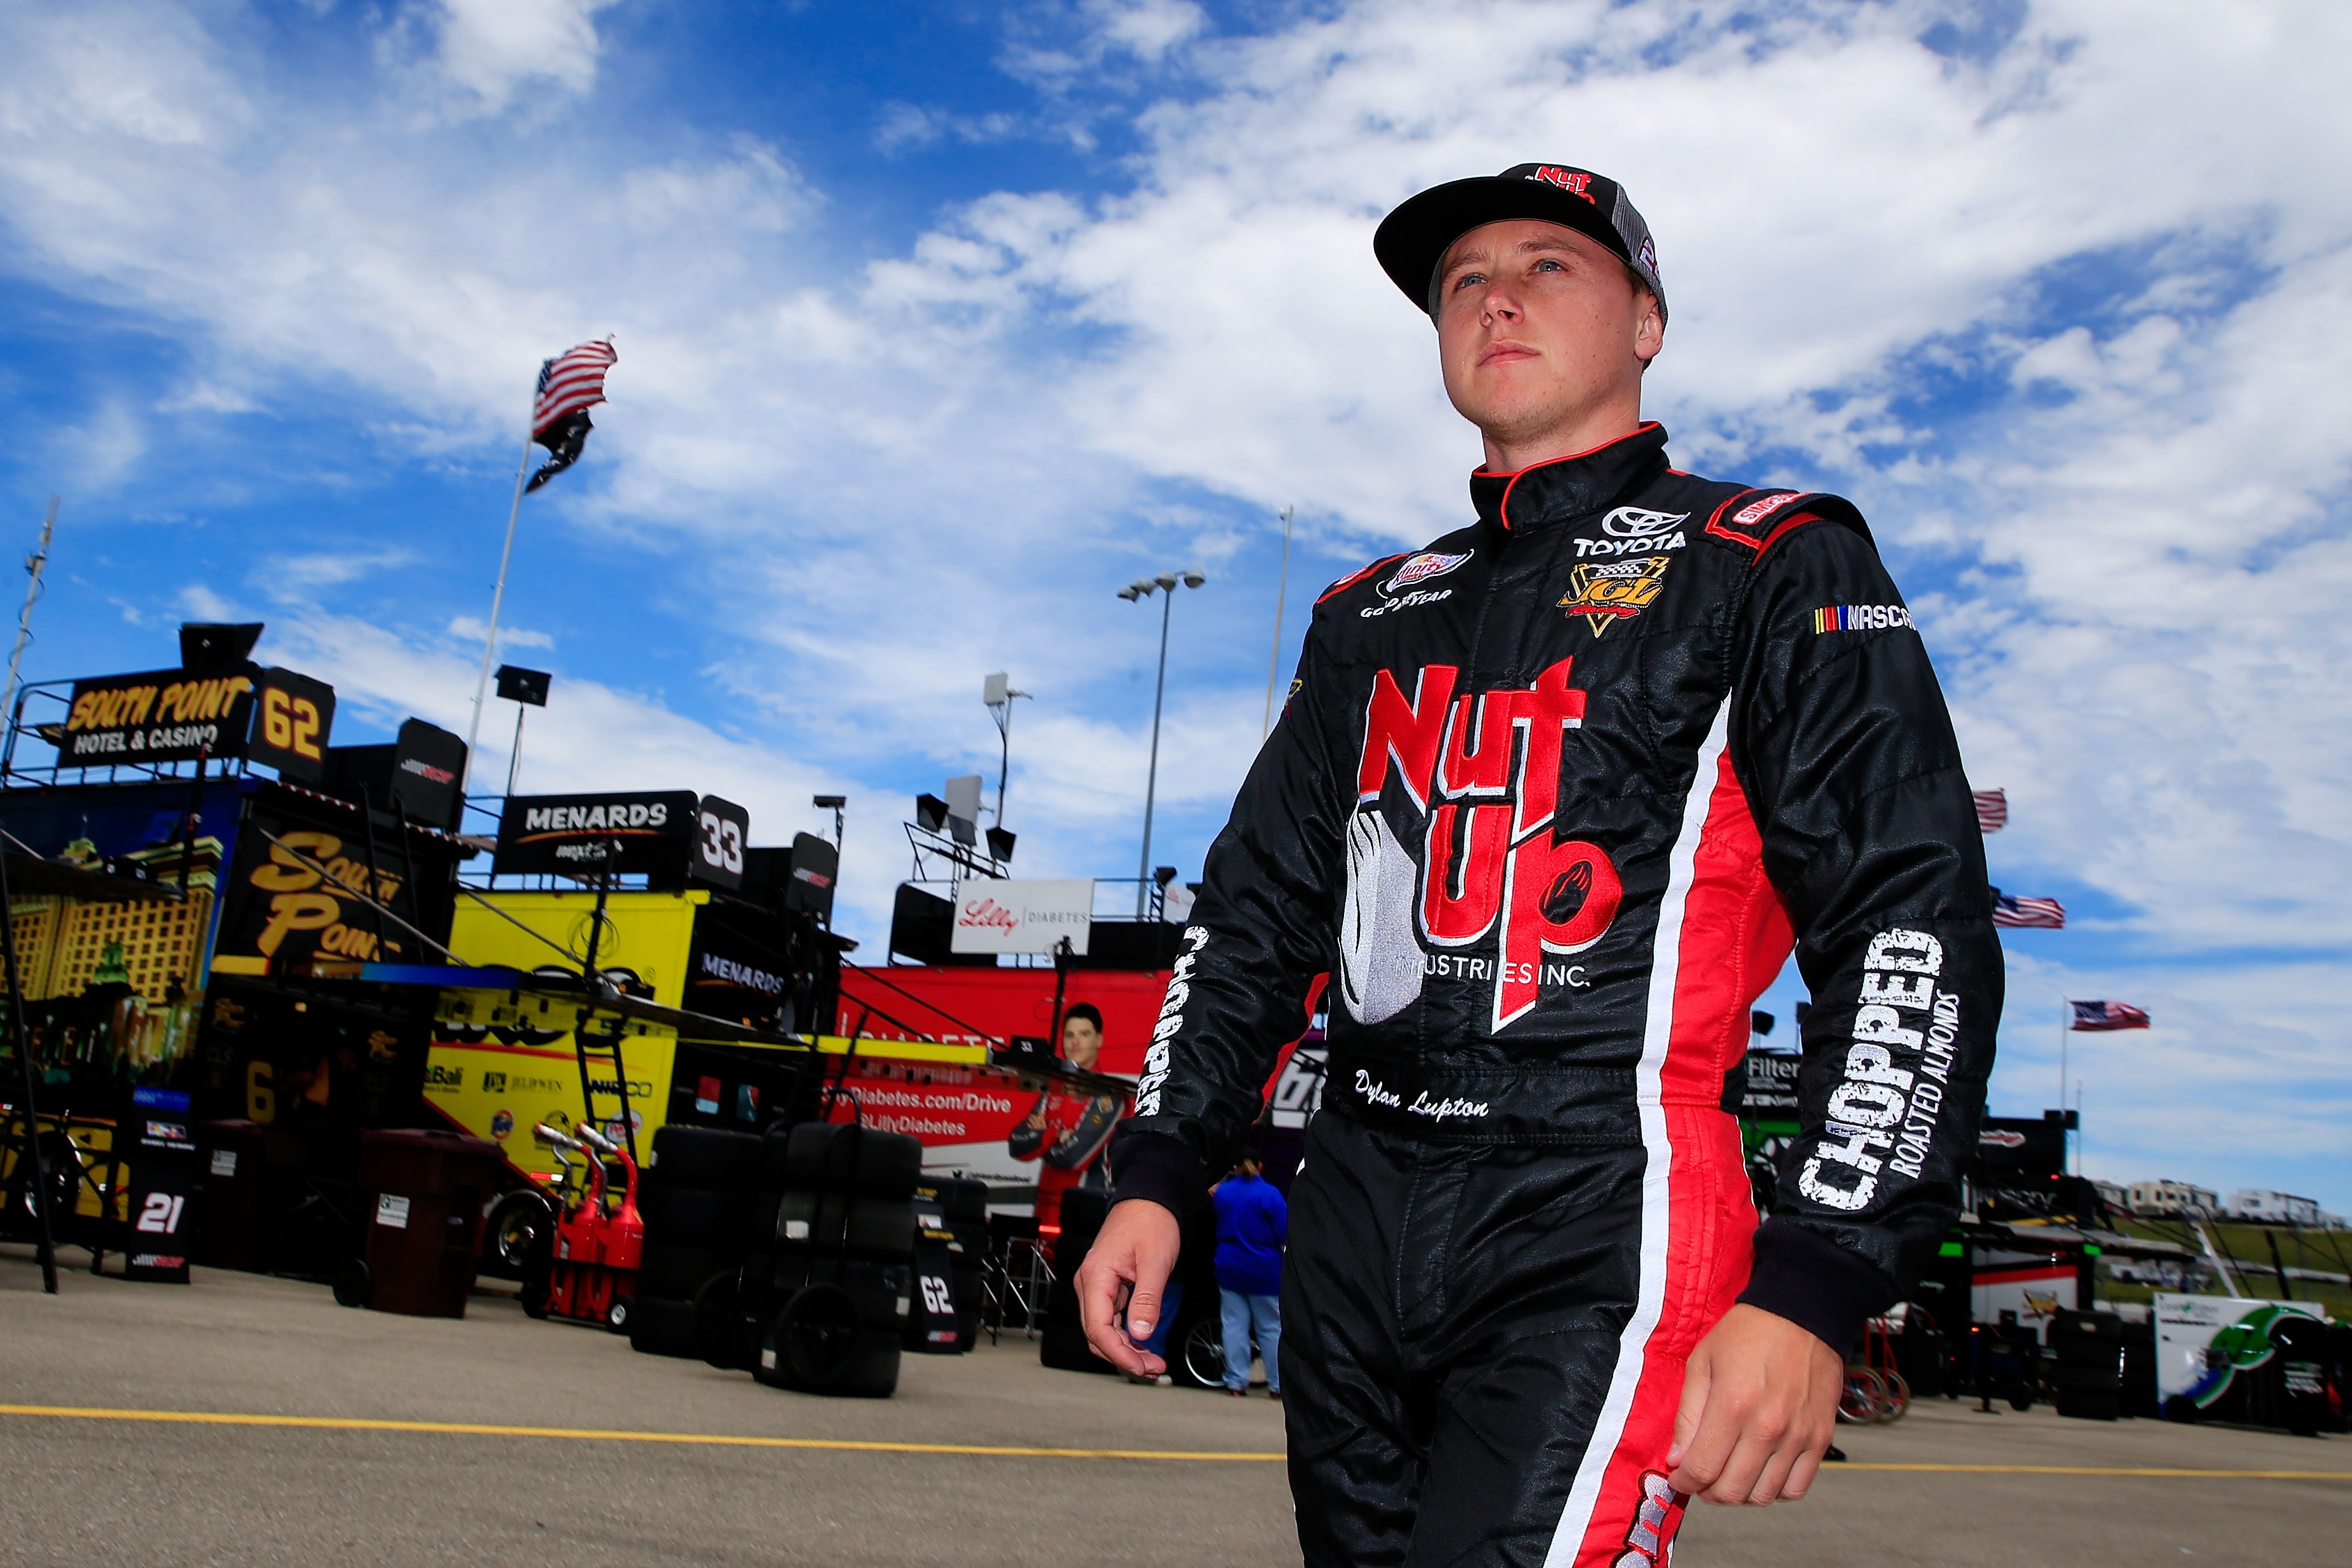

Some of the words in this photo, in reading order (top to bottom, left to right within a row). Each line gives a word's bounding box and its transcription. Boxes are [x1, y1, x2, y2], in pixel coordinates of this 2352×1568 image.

[1534, 164, 1592, 192] Nut
[1573, 531, 1686, 557] TOYOTA
[1848, 604, 1917, 631] NASCA
[66, 684, 159, 732] SOUTH
[155, 674, 254, 724] POINT
[263, 686, 321, 761] 62
[73, 731, 127, 755] HOTEL
[129, 729, 147, 752] &
[1358, 655, 1586, 840] Nut
[525, 803, 669, 832] MENARDS
[700, 811, 745, 874] 33
[959, 898, 1020, 937] Lilly
[1028, 911, 1089, 924] DIABETES
[701, 951, 786, 995] MENARDS
[1537, 964, 1591, 988] INC.
[1798, 927, 1943, 1210] CHOPPED
[1889, 1081, 1944, 1180] ROASTED
[1920, 988, 1961, 1085] ALMONDS
[1355, 1069, 1401, 1108] Dylan
[1407, 1089, 1490, 1123] Lupton
[135, 1190, 186, 1235] 21
[919, 1275, 956, 1315] 62
